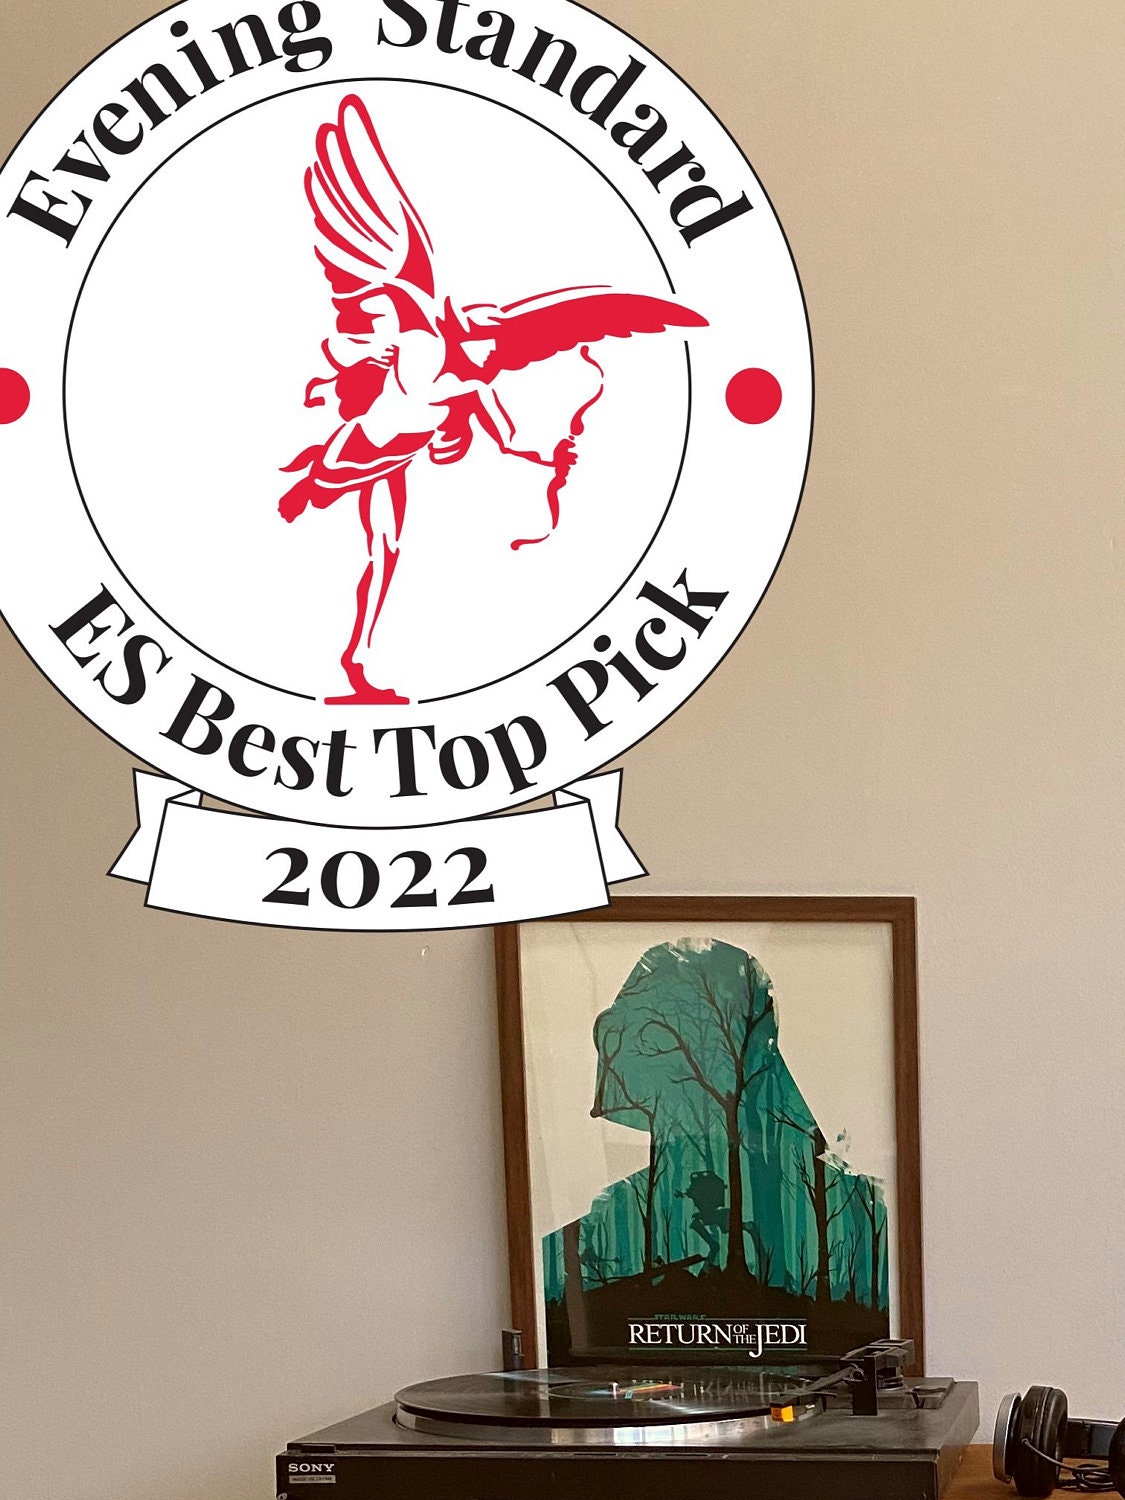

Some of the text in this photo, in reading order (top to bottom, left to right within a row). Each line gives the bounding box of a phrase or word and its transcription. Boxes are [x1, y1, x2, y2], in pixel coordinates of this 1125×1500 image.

[628, 1324, 807, 1358] RETURN OF THE JEDI
[288, 1463, 335, 1472] SONY
